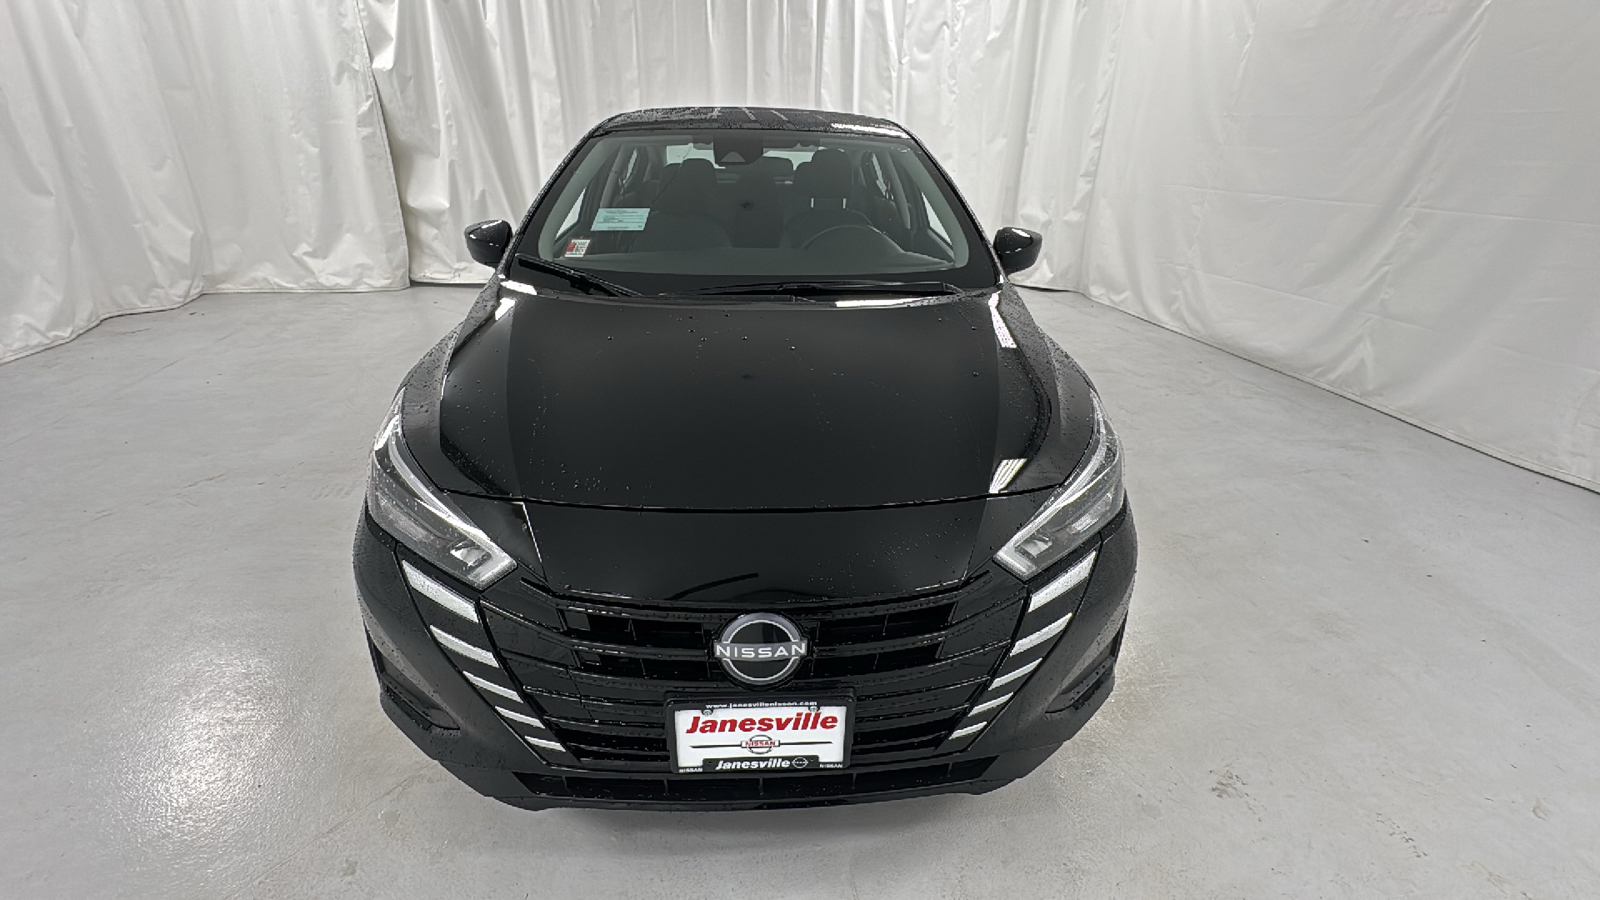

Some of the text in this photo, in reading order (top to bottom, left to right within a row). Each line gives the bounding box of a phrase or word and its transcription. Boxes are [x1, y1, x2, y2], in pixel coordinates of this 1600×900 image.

[716, 642, 806, 658] NISSAN
[706, 701, 818, 709] www.janesvillenissan.com
[685, 711, 839, 734] Janesville
[715, 758, 791, 770] Janesville
